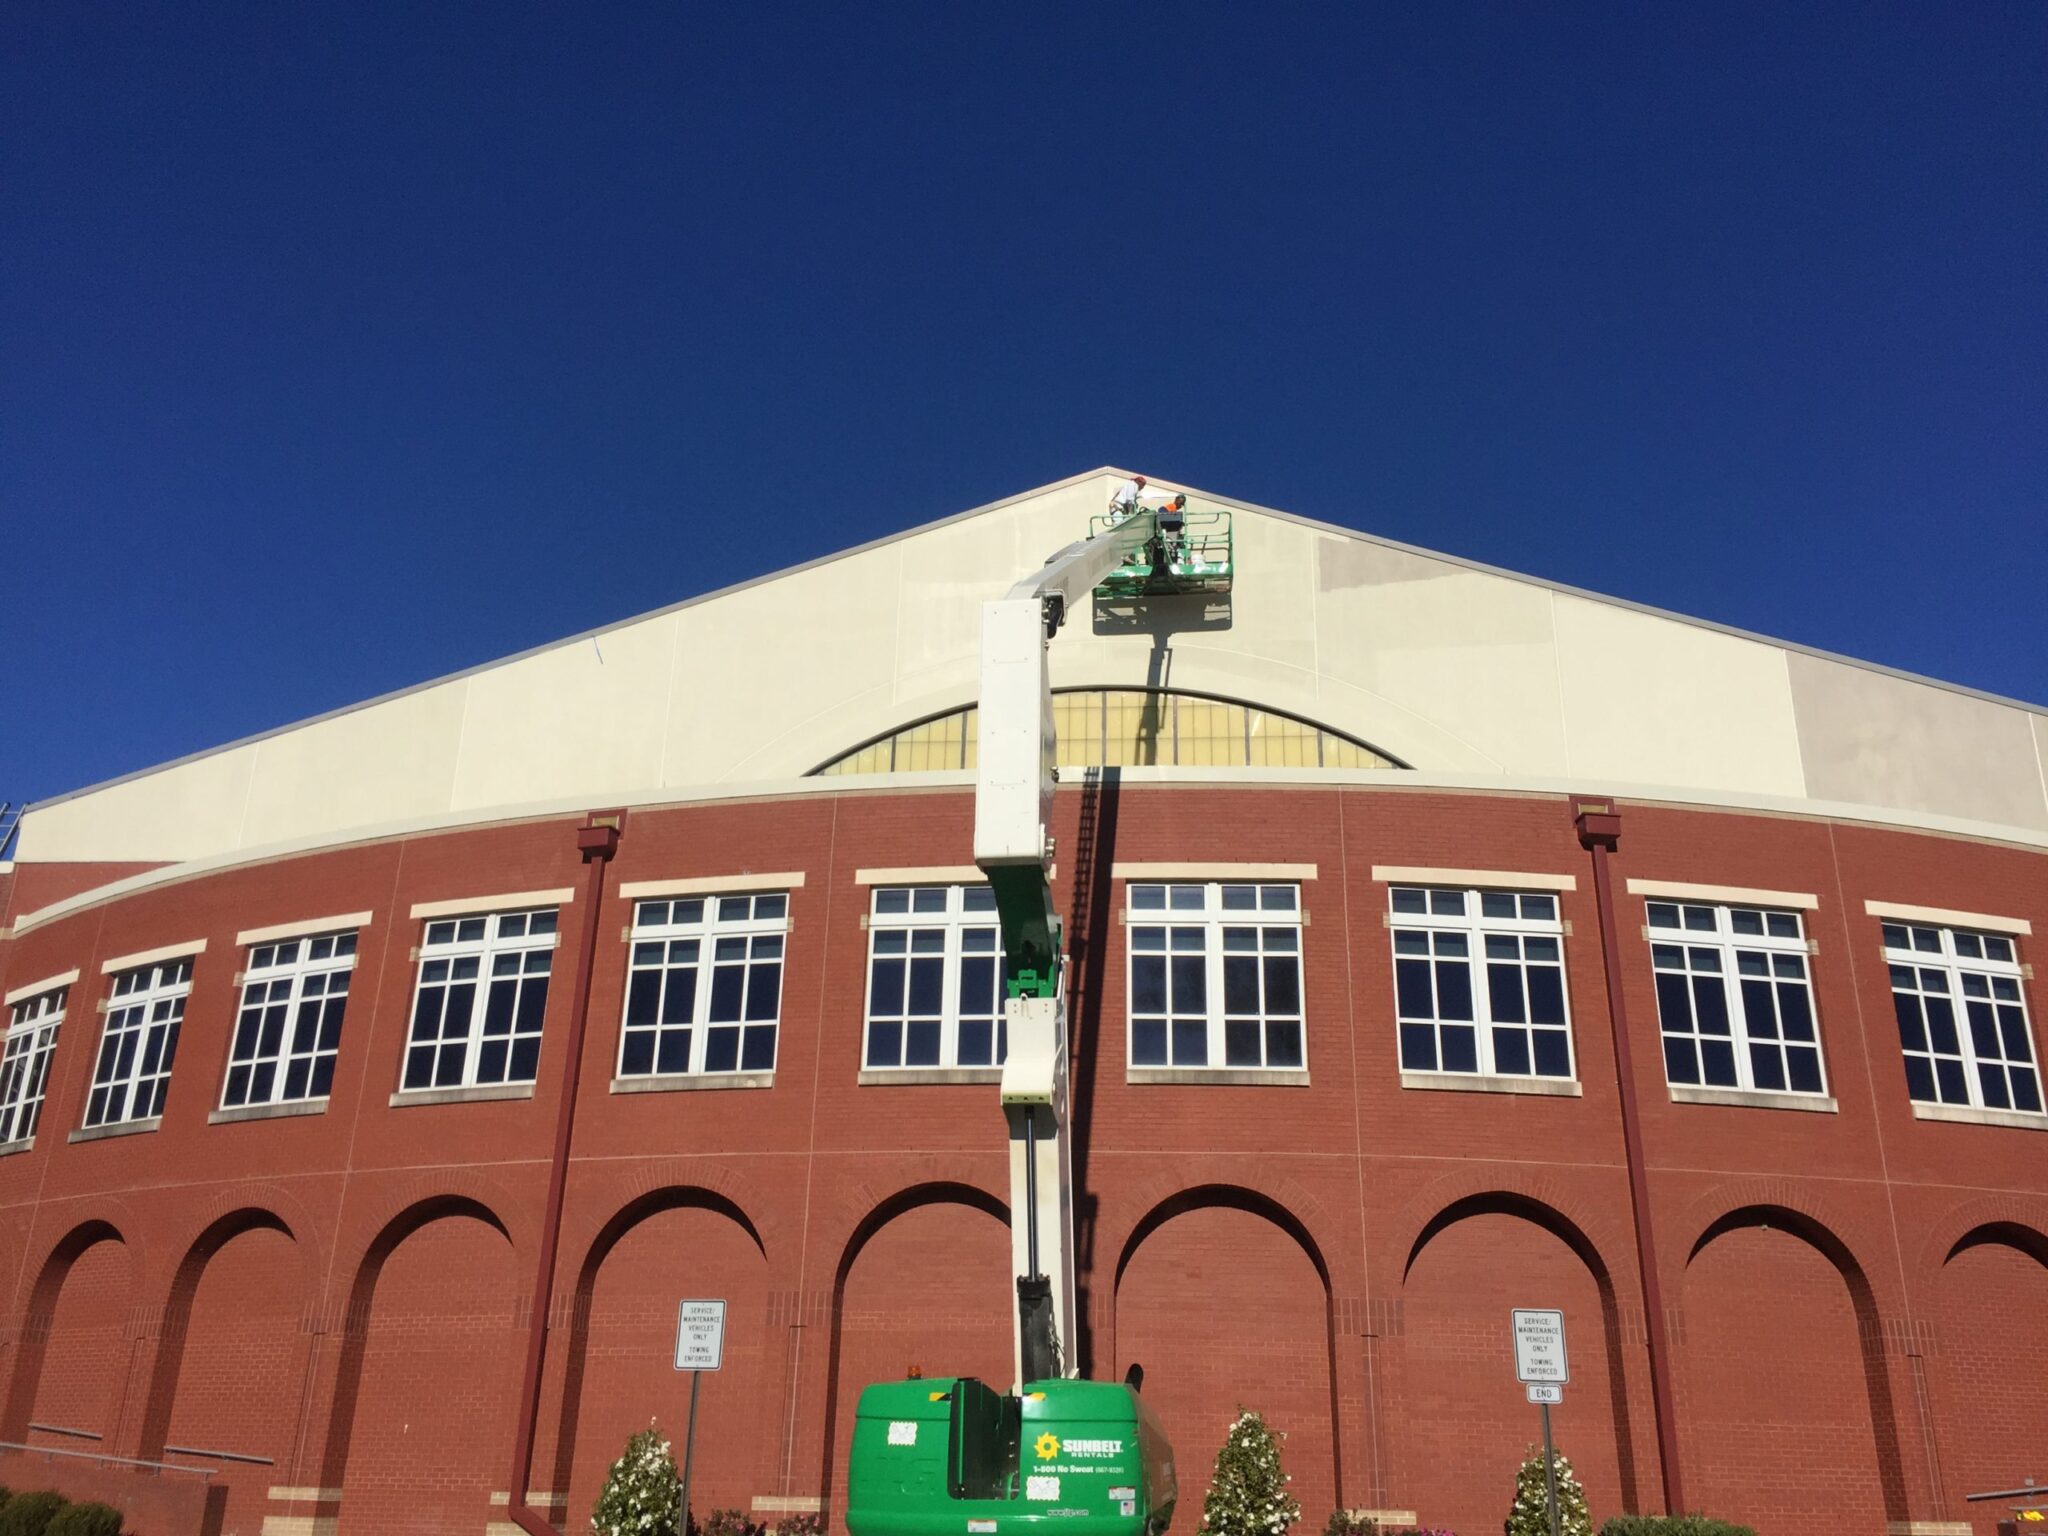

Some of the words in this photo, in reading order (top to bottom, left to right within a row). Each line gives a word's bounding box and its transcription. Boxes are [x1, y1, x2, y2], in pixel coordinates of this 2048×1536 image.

[1518, 1327, 1559, 1335] MAINTENANCE
[1527, 1367, 1558, 1375] ENFORCED
[1536, 1389, 1552, 1398] END
[1062, 1440, 1122, 1452] SUNBELT
[1033, 1465, 1056, 1473] 1-800
[1057, 1465, 1069, 1473] No
[1070, 1465, 1094, 1473] Sweat
